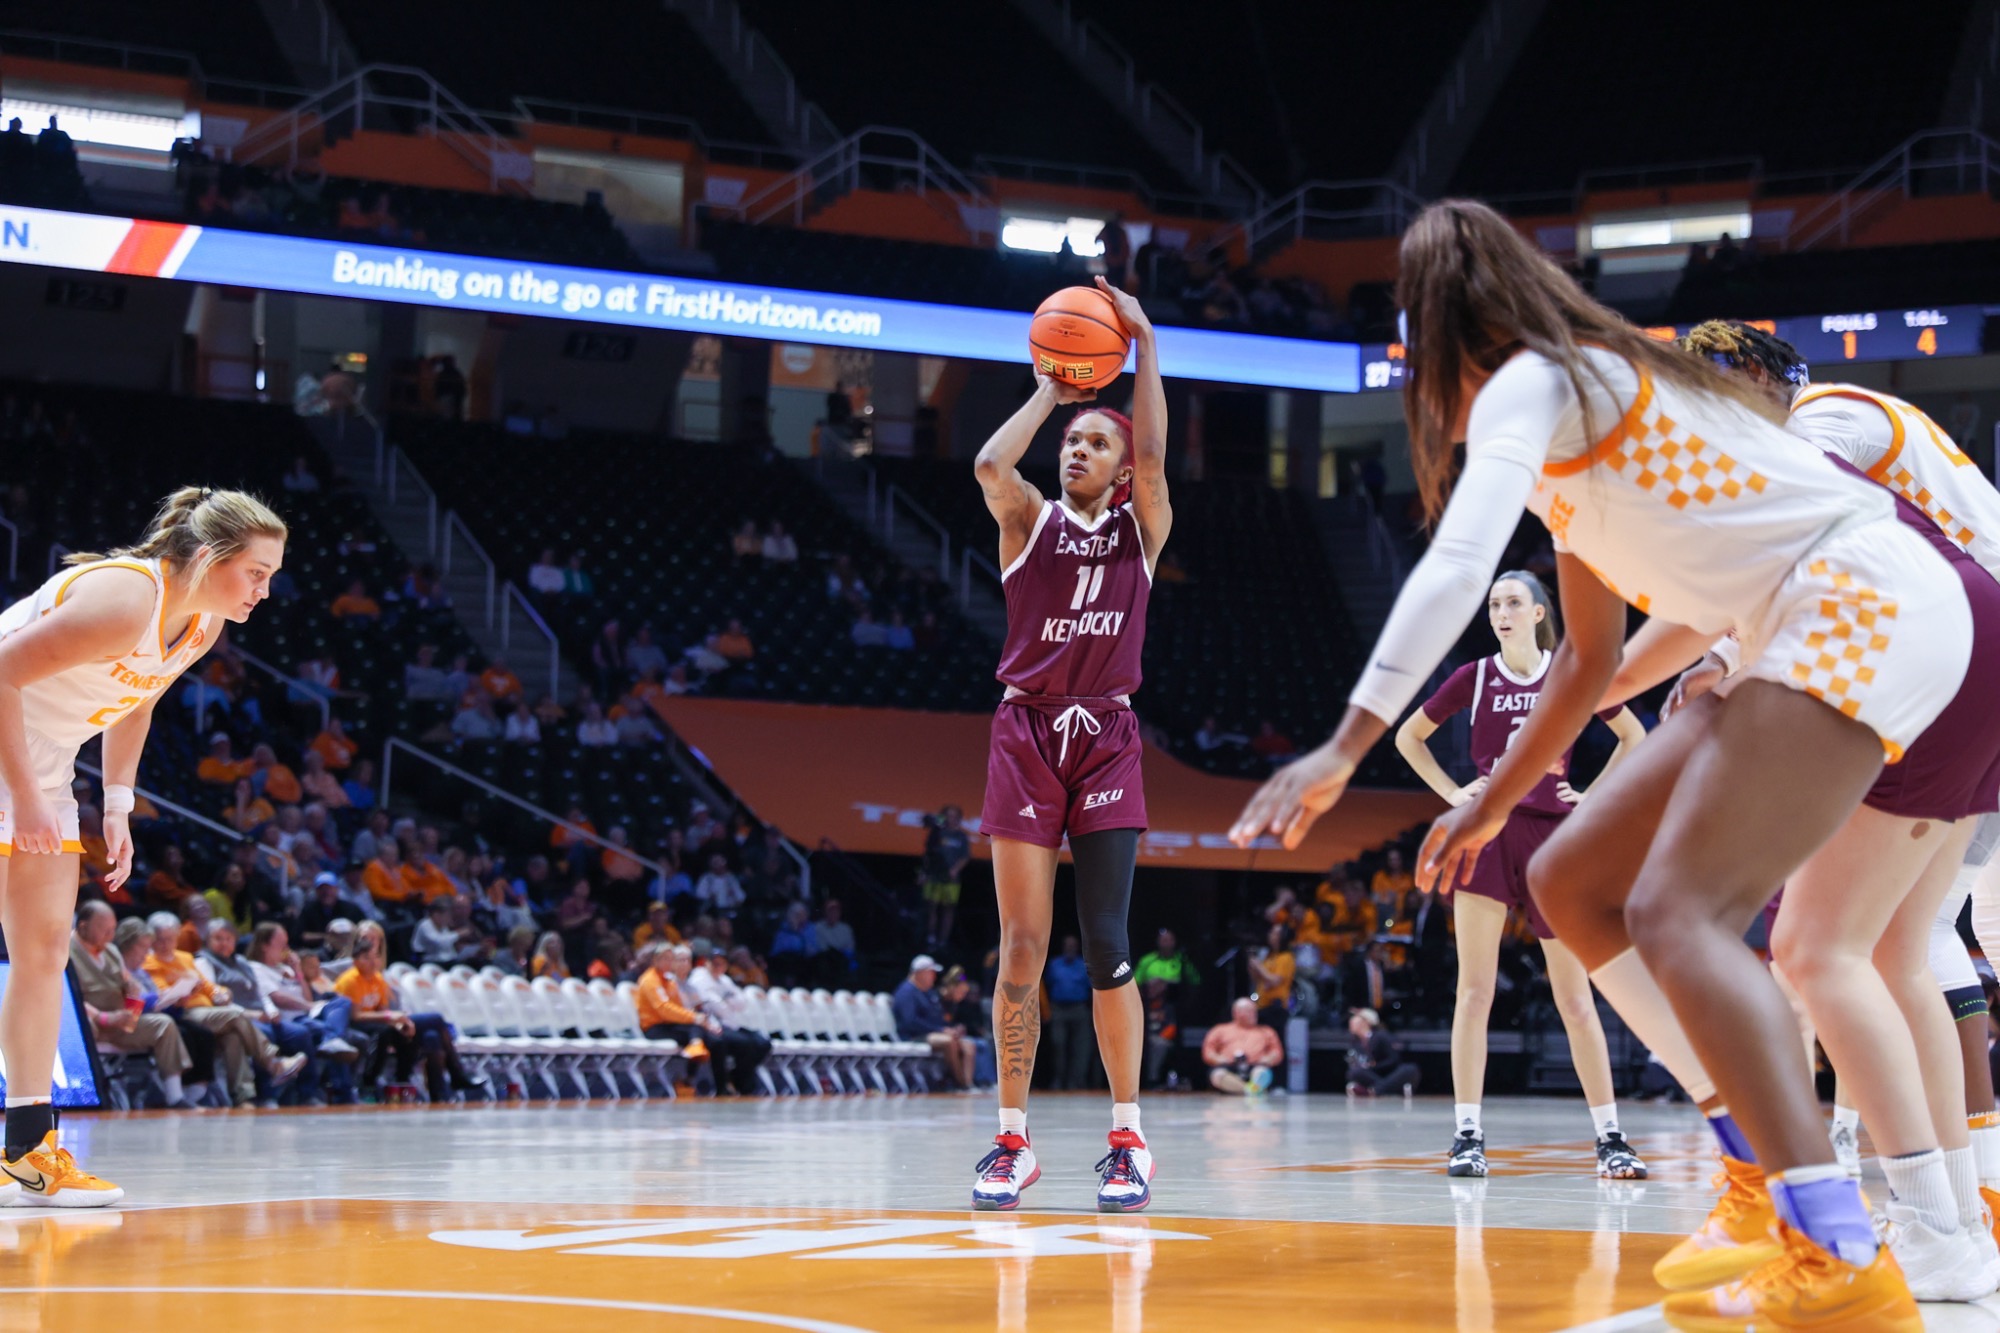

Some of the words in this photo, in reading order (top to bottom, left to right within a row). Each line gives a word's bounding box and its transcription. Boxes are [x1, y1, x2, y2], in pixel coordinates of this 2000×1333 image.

[333, 250, 460, 300] Banking
[463, 271, 503, 298] on
[509, 269, 560, 304] the
[561, 281, 601, 312] go
[605, 283, 639, 312] at
[645, 283, 882, 337] FirstHorizon.com
[1843, 330, 1857, 359] 1
[1916, 327, 1937, 355] 4
[1084, 788, 1124, 807] EKU
